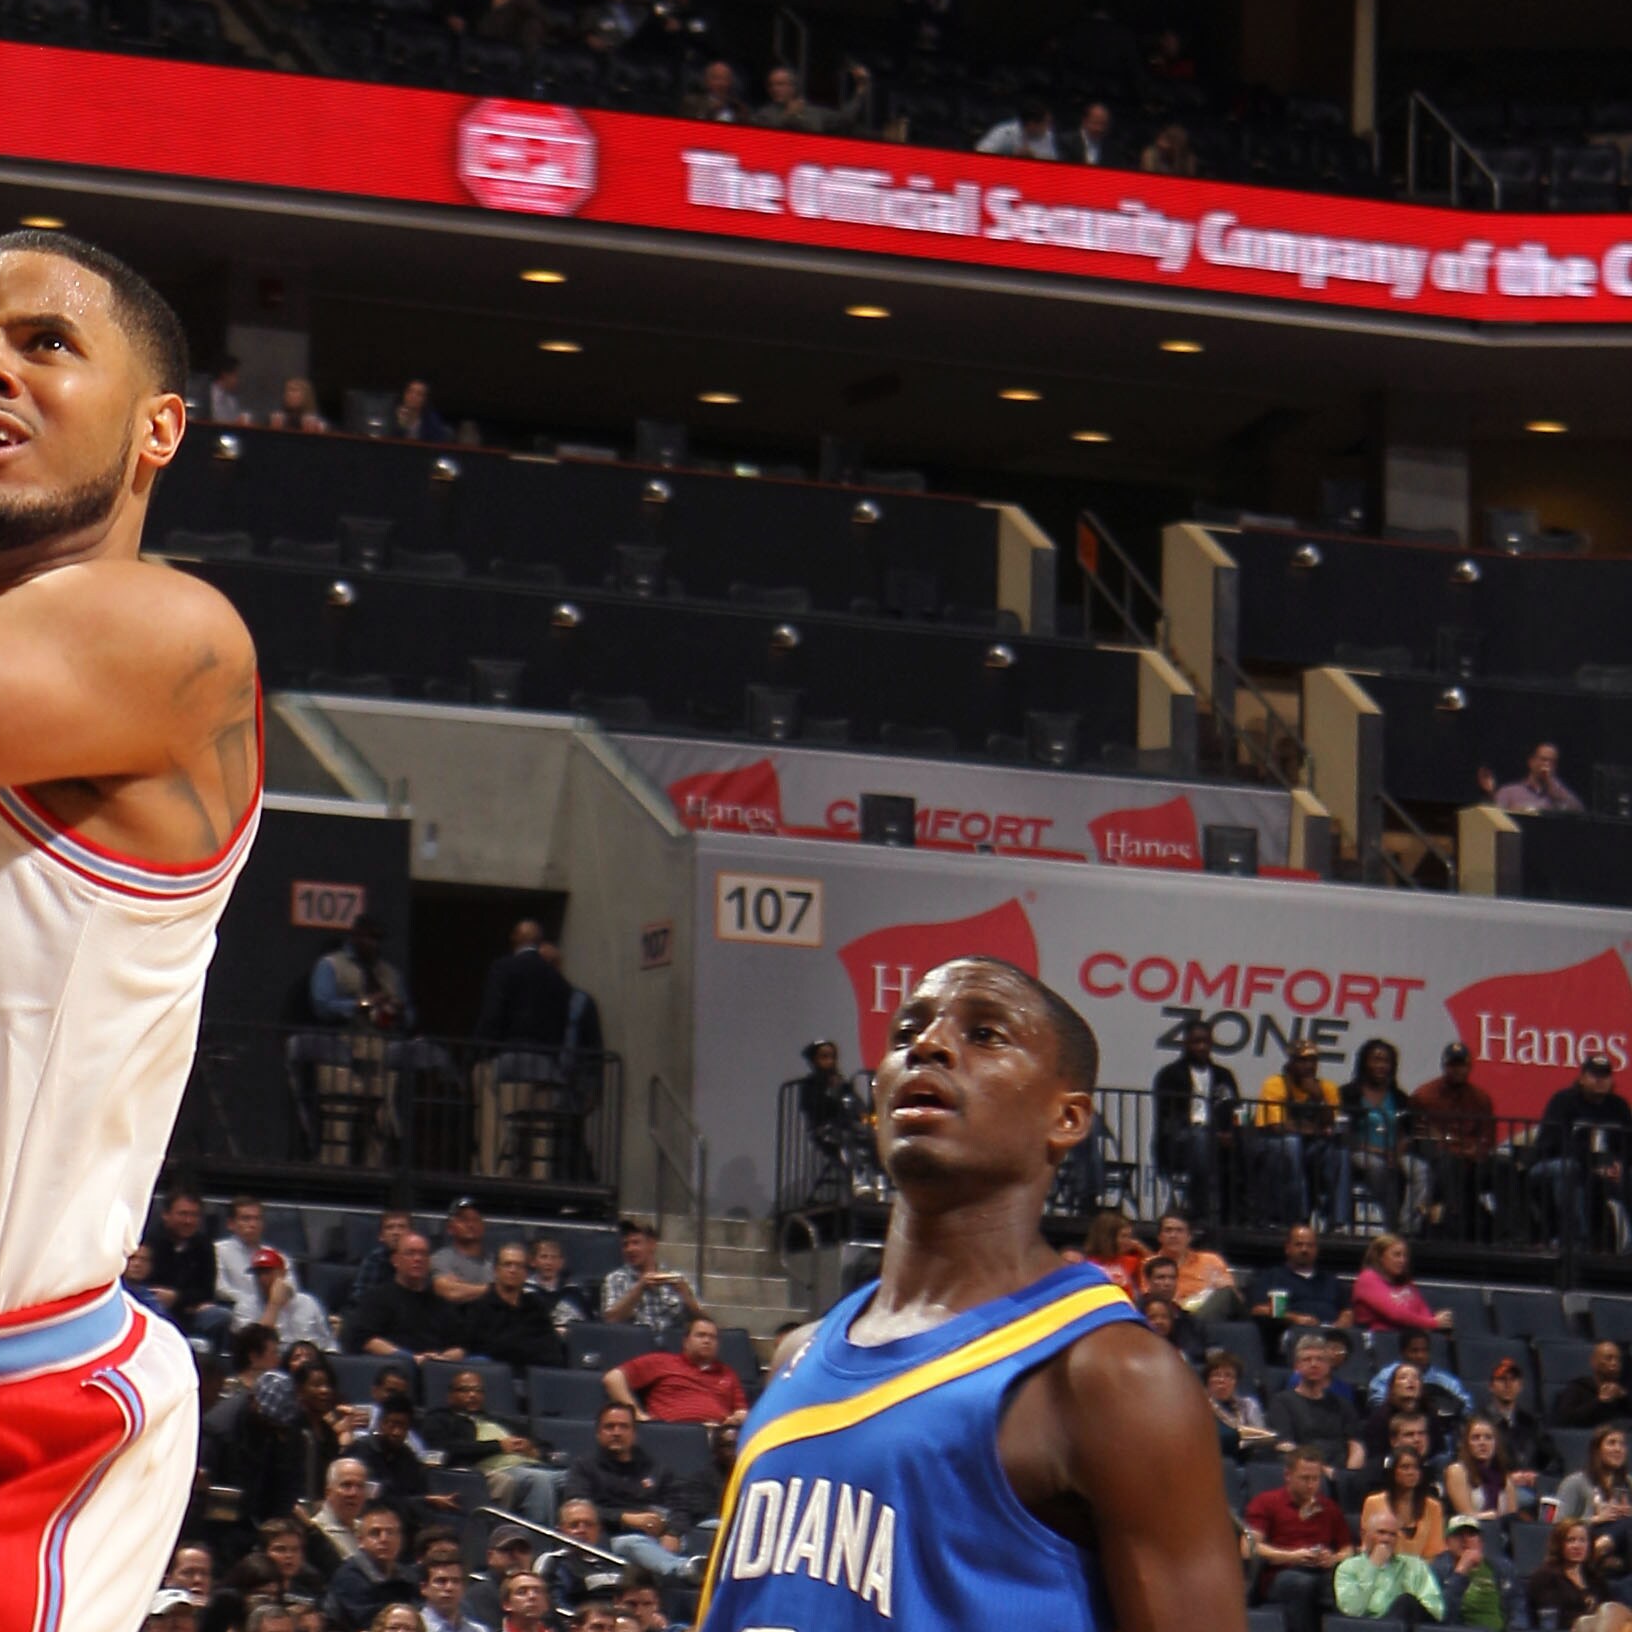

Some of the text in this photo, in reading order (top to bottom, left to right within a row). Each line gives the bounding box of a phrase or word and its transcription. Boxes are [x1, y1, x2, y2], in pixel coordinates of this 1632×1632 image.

[682, 149, 784, 215] The
[790, 163, 981, 238] Official
[984, 187, 1194, 272] Security
[1198, 210, 1429, 300] Company
[1430, 240, 1495, 295] of
[1495, 242, 1599, 298] the
[298, 889, 358, 922] 107
[723, 884, 815, 935] 107
[1078, 951, 1425, 1021] COMFORT
[1154, 1004, 1350, 1064] ZONE
[1475, 1012, 1628, 1073] Hanes
[721, 1476, 896, 1619] DIANA
